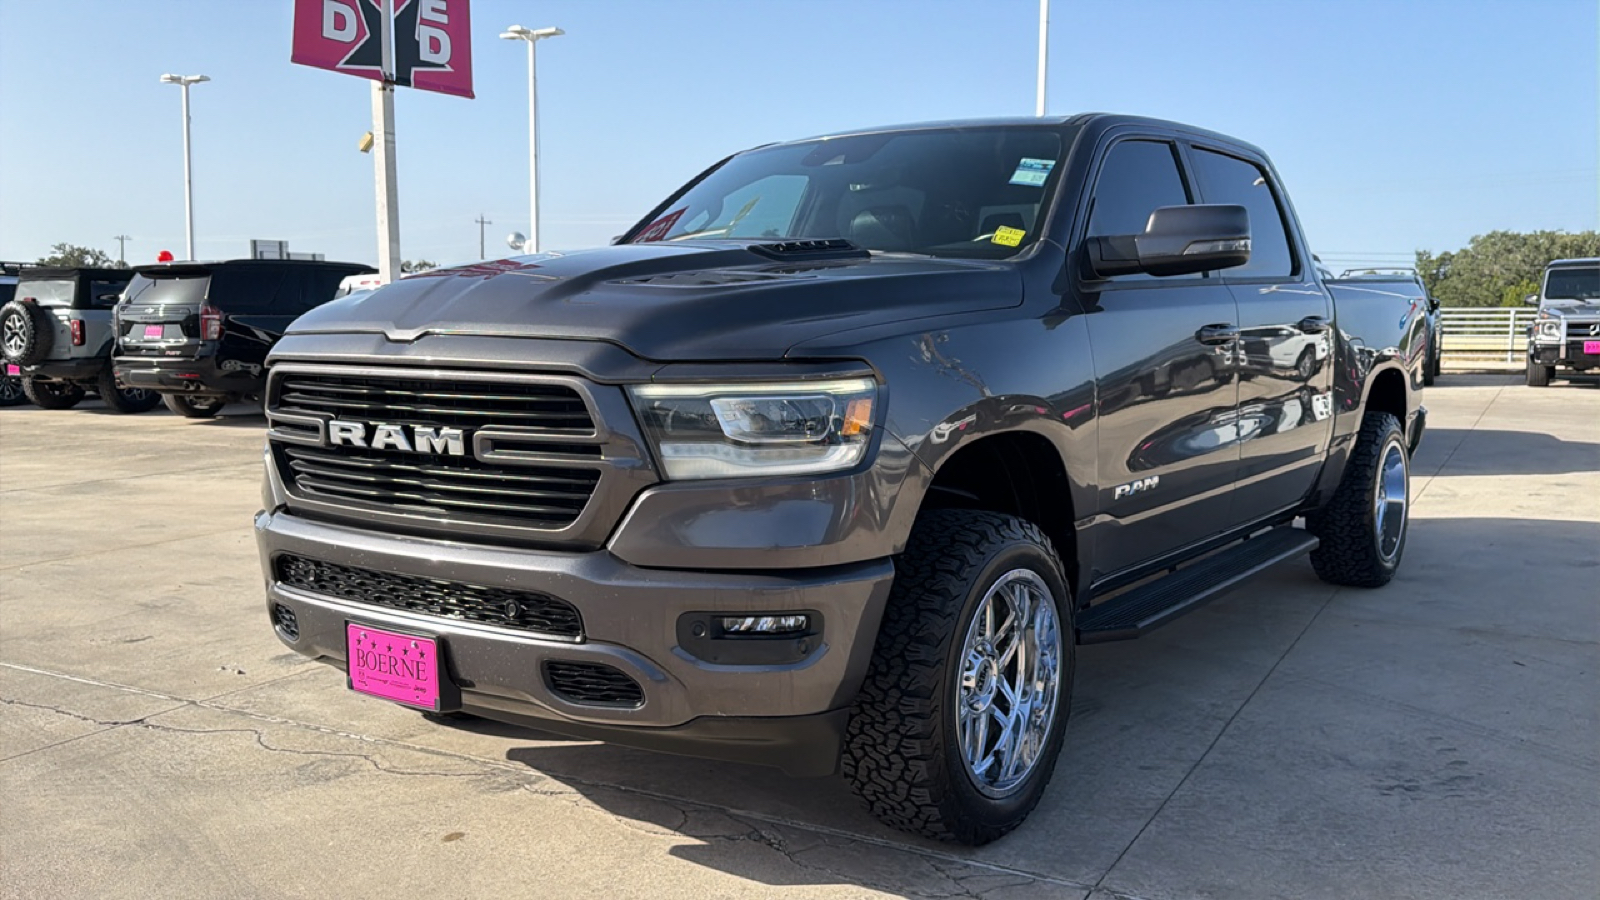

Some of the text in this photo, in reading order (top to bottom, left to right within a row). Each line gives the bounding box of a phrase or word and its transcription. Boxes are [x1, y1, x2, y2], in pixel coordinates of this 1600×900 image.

[329, 420, 465, 455] RAM
[1114, 475, 1160, 500] RAM
[356, 648, 428, 682] BOERNE
